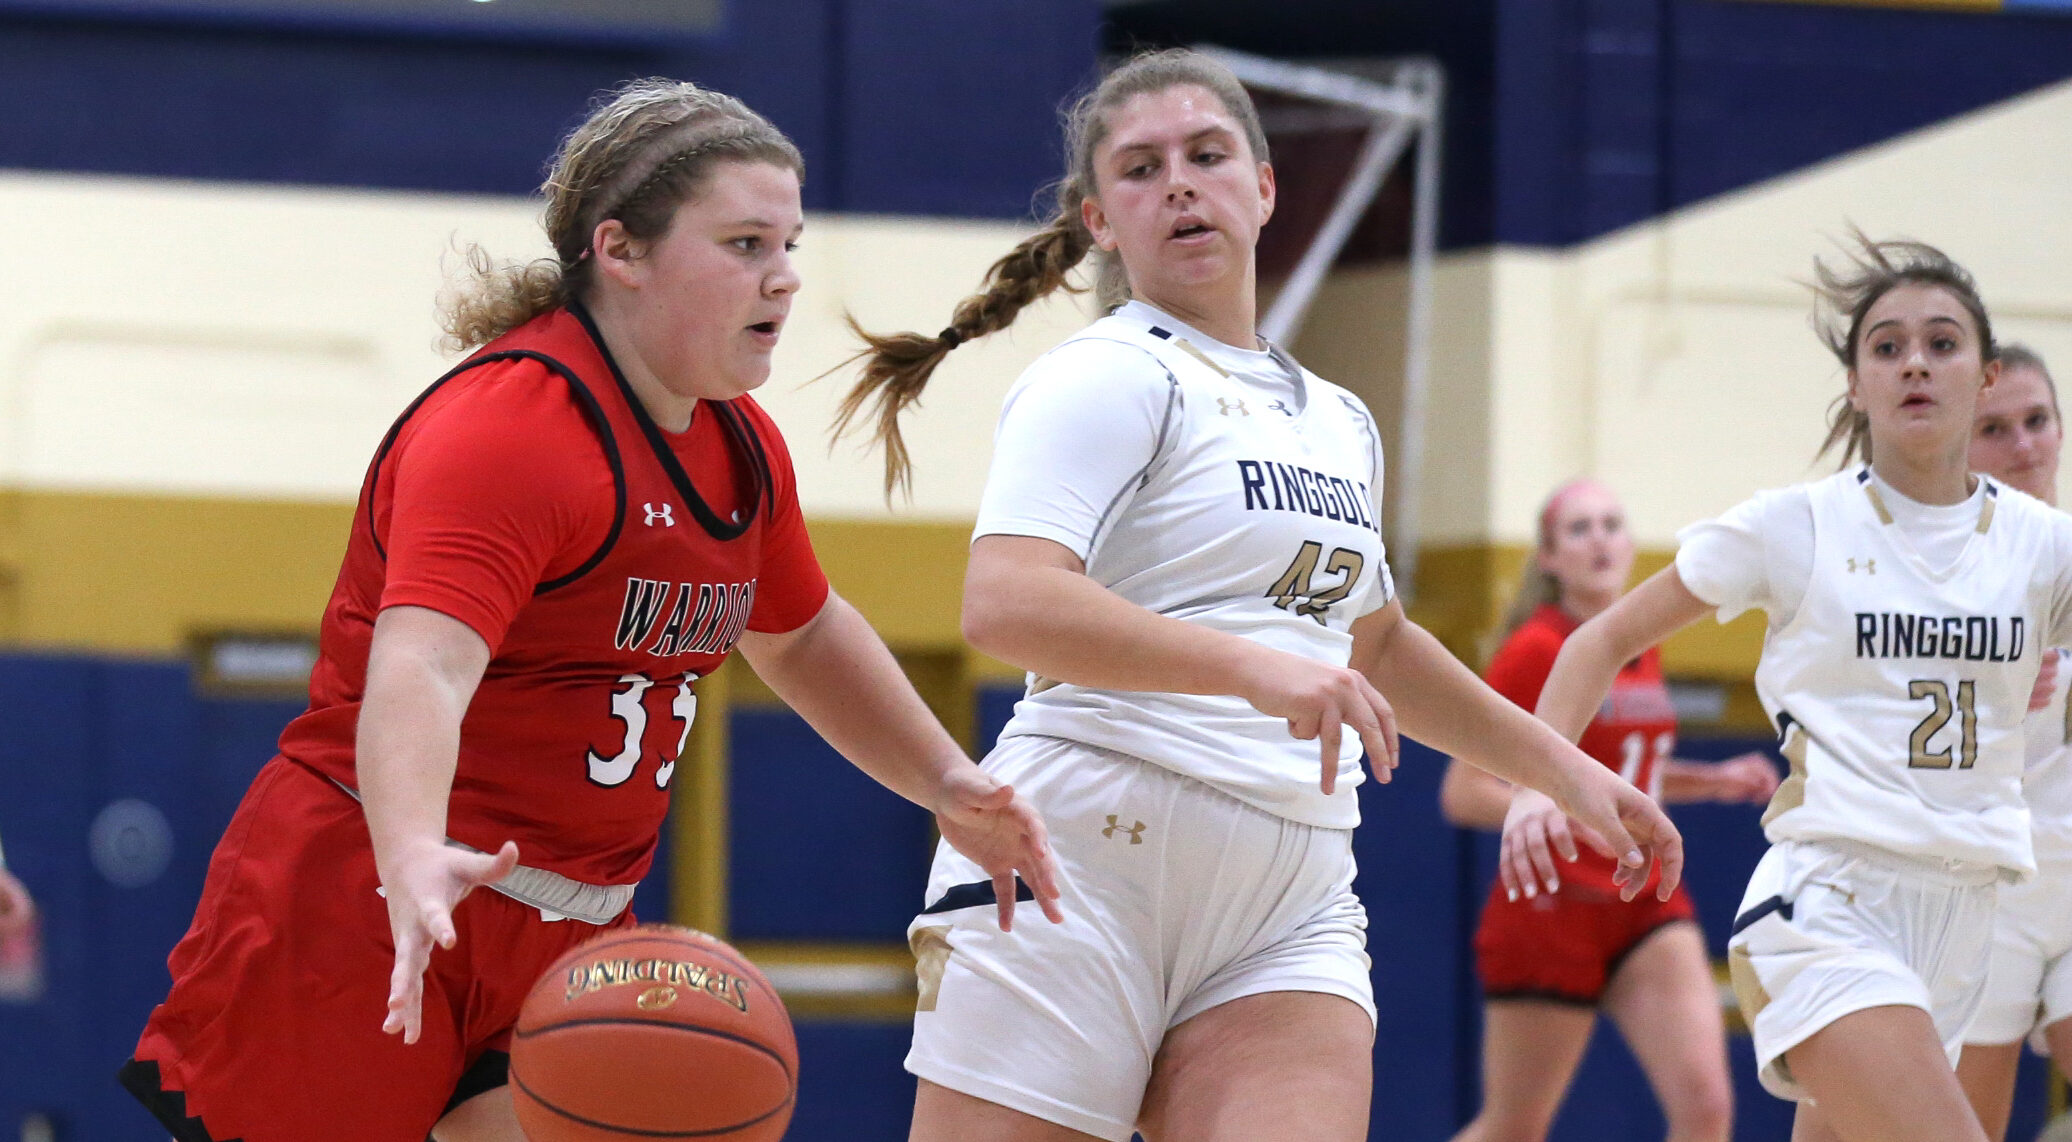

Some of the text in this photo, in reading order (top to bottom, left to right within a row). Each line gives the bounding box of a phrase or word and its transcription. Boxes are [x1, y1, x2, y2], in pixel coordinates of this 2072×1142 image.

[614, 577, 757, 657] WARRIO
[1264, 540, 1364, 627] 42
[1855, 613, 2024, 662] RINGGOLD
[1908, 679, 1978, 769] 21
[564, 958, 750, 1014] SPALDING
